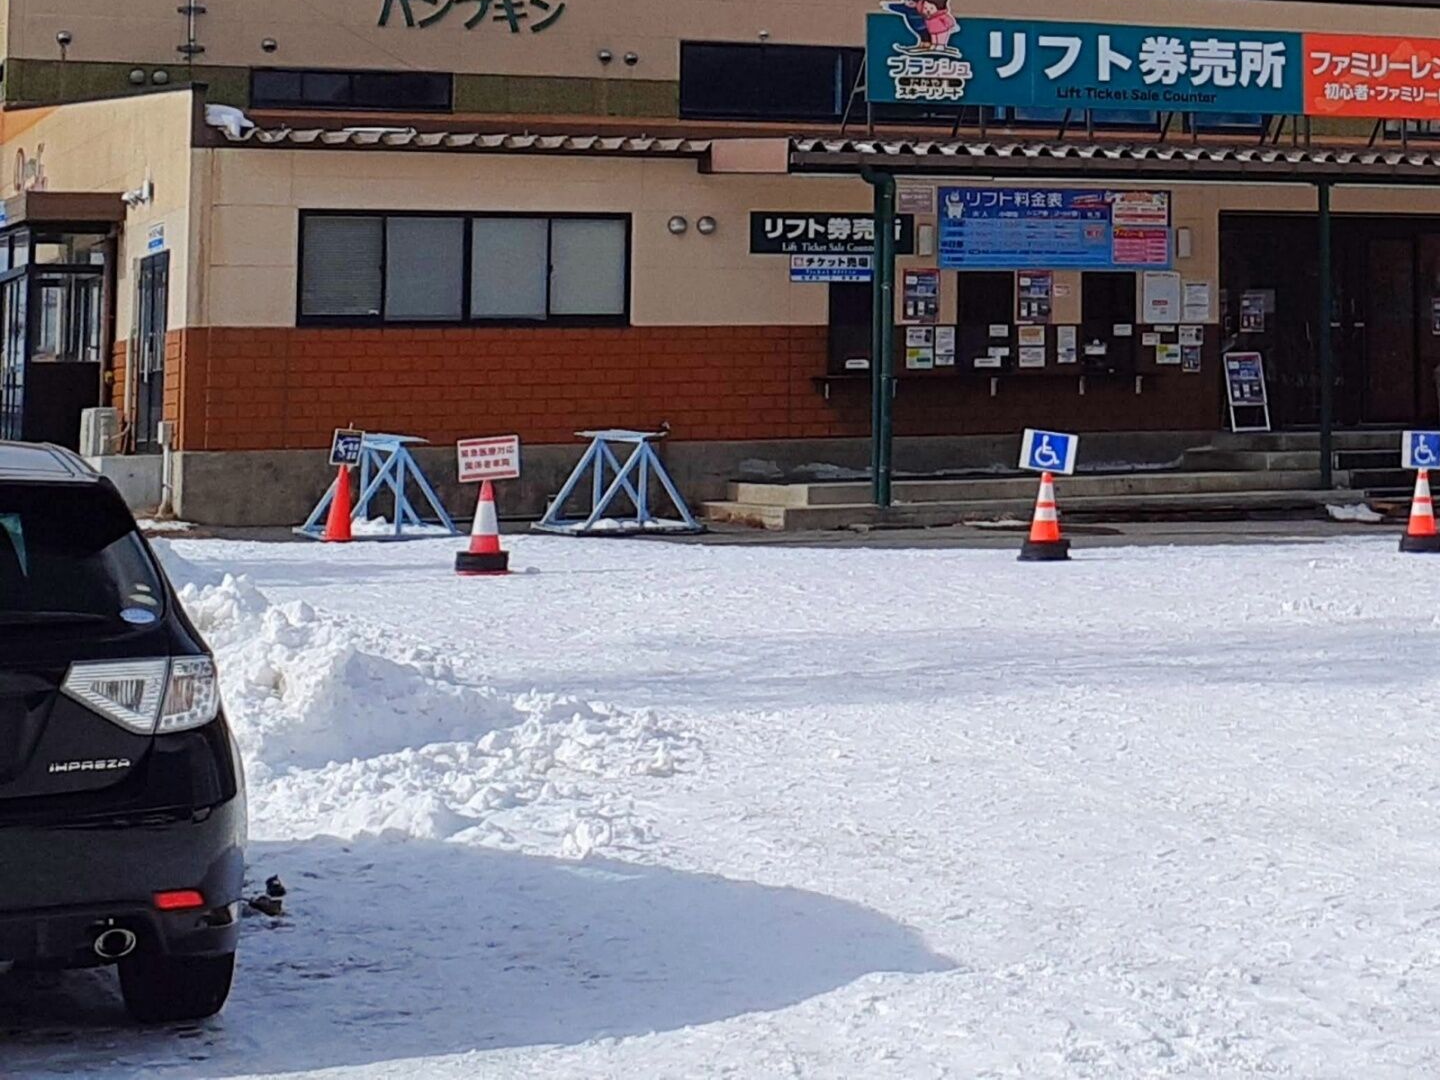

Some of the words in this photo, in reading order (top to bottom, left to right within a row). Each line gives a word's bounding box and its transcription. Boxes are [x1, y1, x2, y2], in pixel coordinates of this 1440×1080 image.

[989, 30, 1287, 89] リフト券売所
[1056, 87, 1082, 99] Lift
[1085, 88, 1127, 101] Ticket
[1131, 89, 1160, 102] Sale
[1163, 90, 1217, 104] Counter
[966, 191, 1063, 208] リフト料金表
[782, 242, 798, 252] Lift
[801, 242, 828, 252] Ticket
[48, 758, 131, 773] IMPREZA
